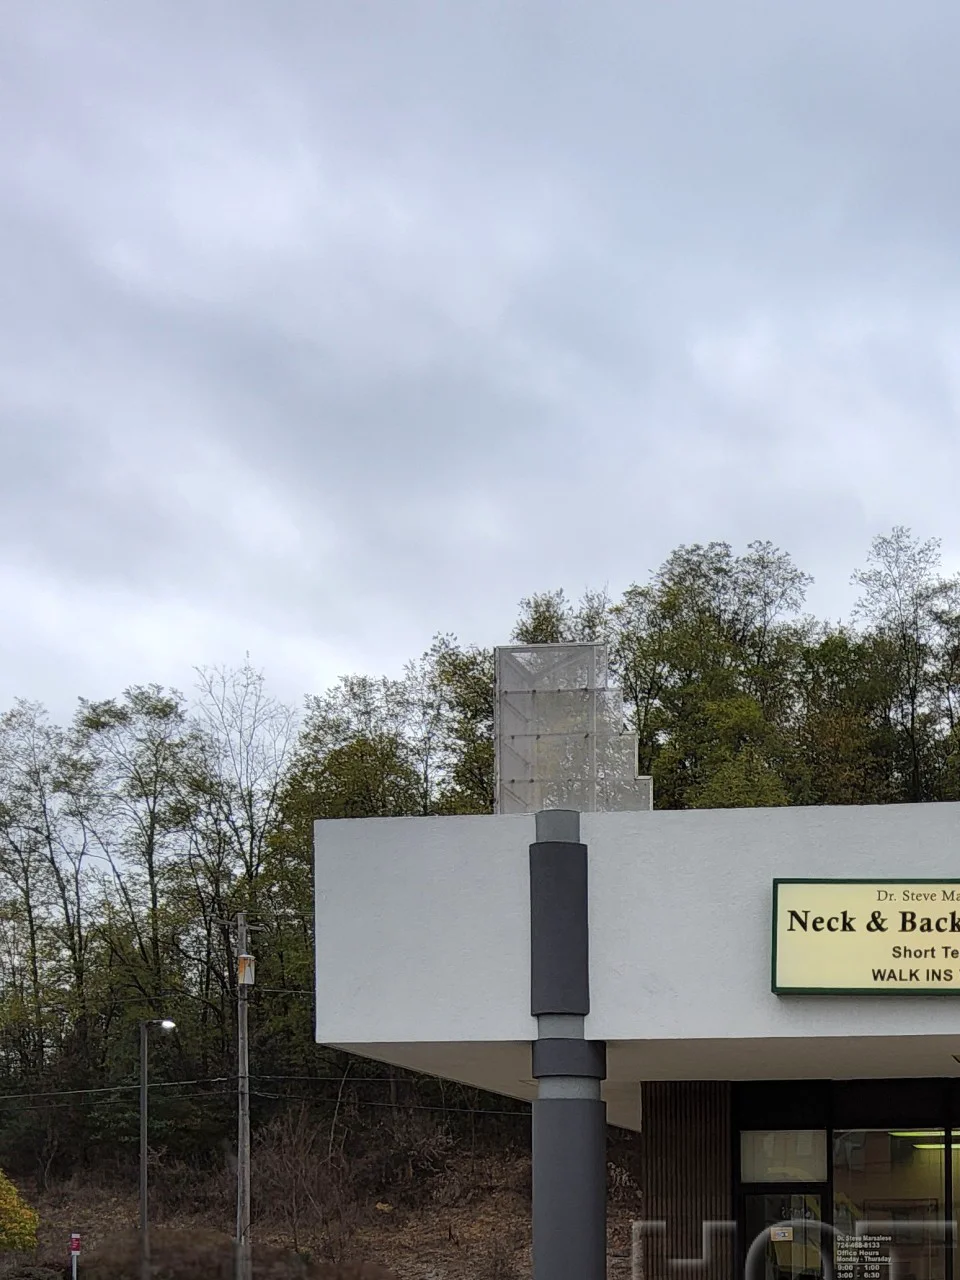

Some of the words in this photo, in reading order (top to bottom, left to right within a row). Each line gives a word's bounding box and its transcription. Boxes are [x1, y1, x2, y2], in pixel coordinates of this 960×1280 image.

[876, 889, 897, 902] Dr.
[902, 889, 937, 902] Steve
[786, 909, 856, 932] Neck
[865, 910, 889, 932] &
[891, 945, 936, 959] Short
[872, 968, 920, 982] WALK
[926, 968, 953, 982] INS
